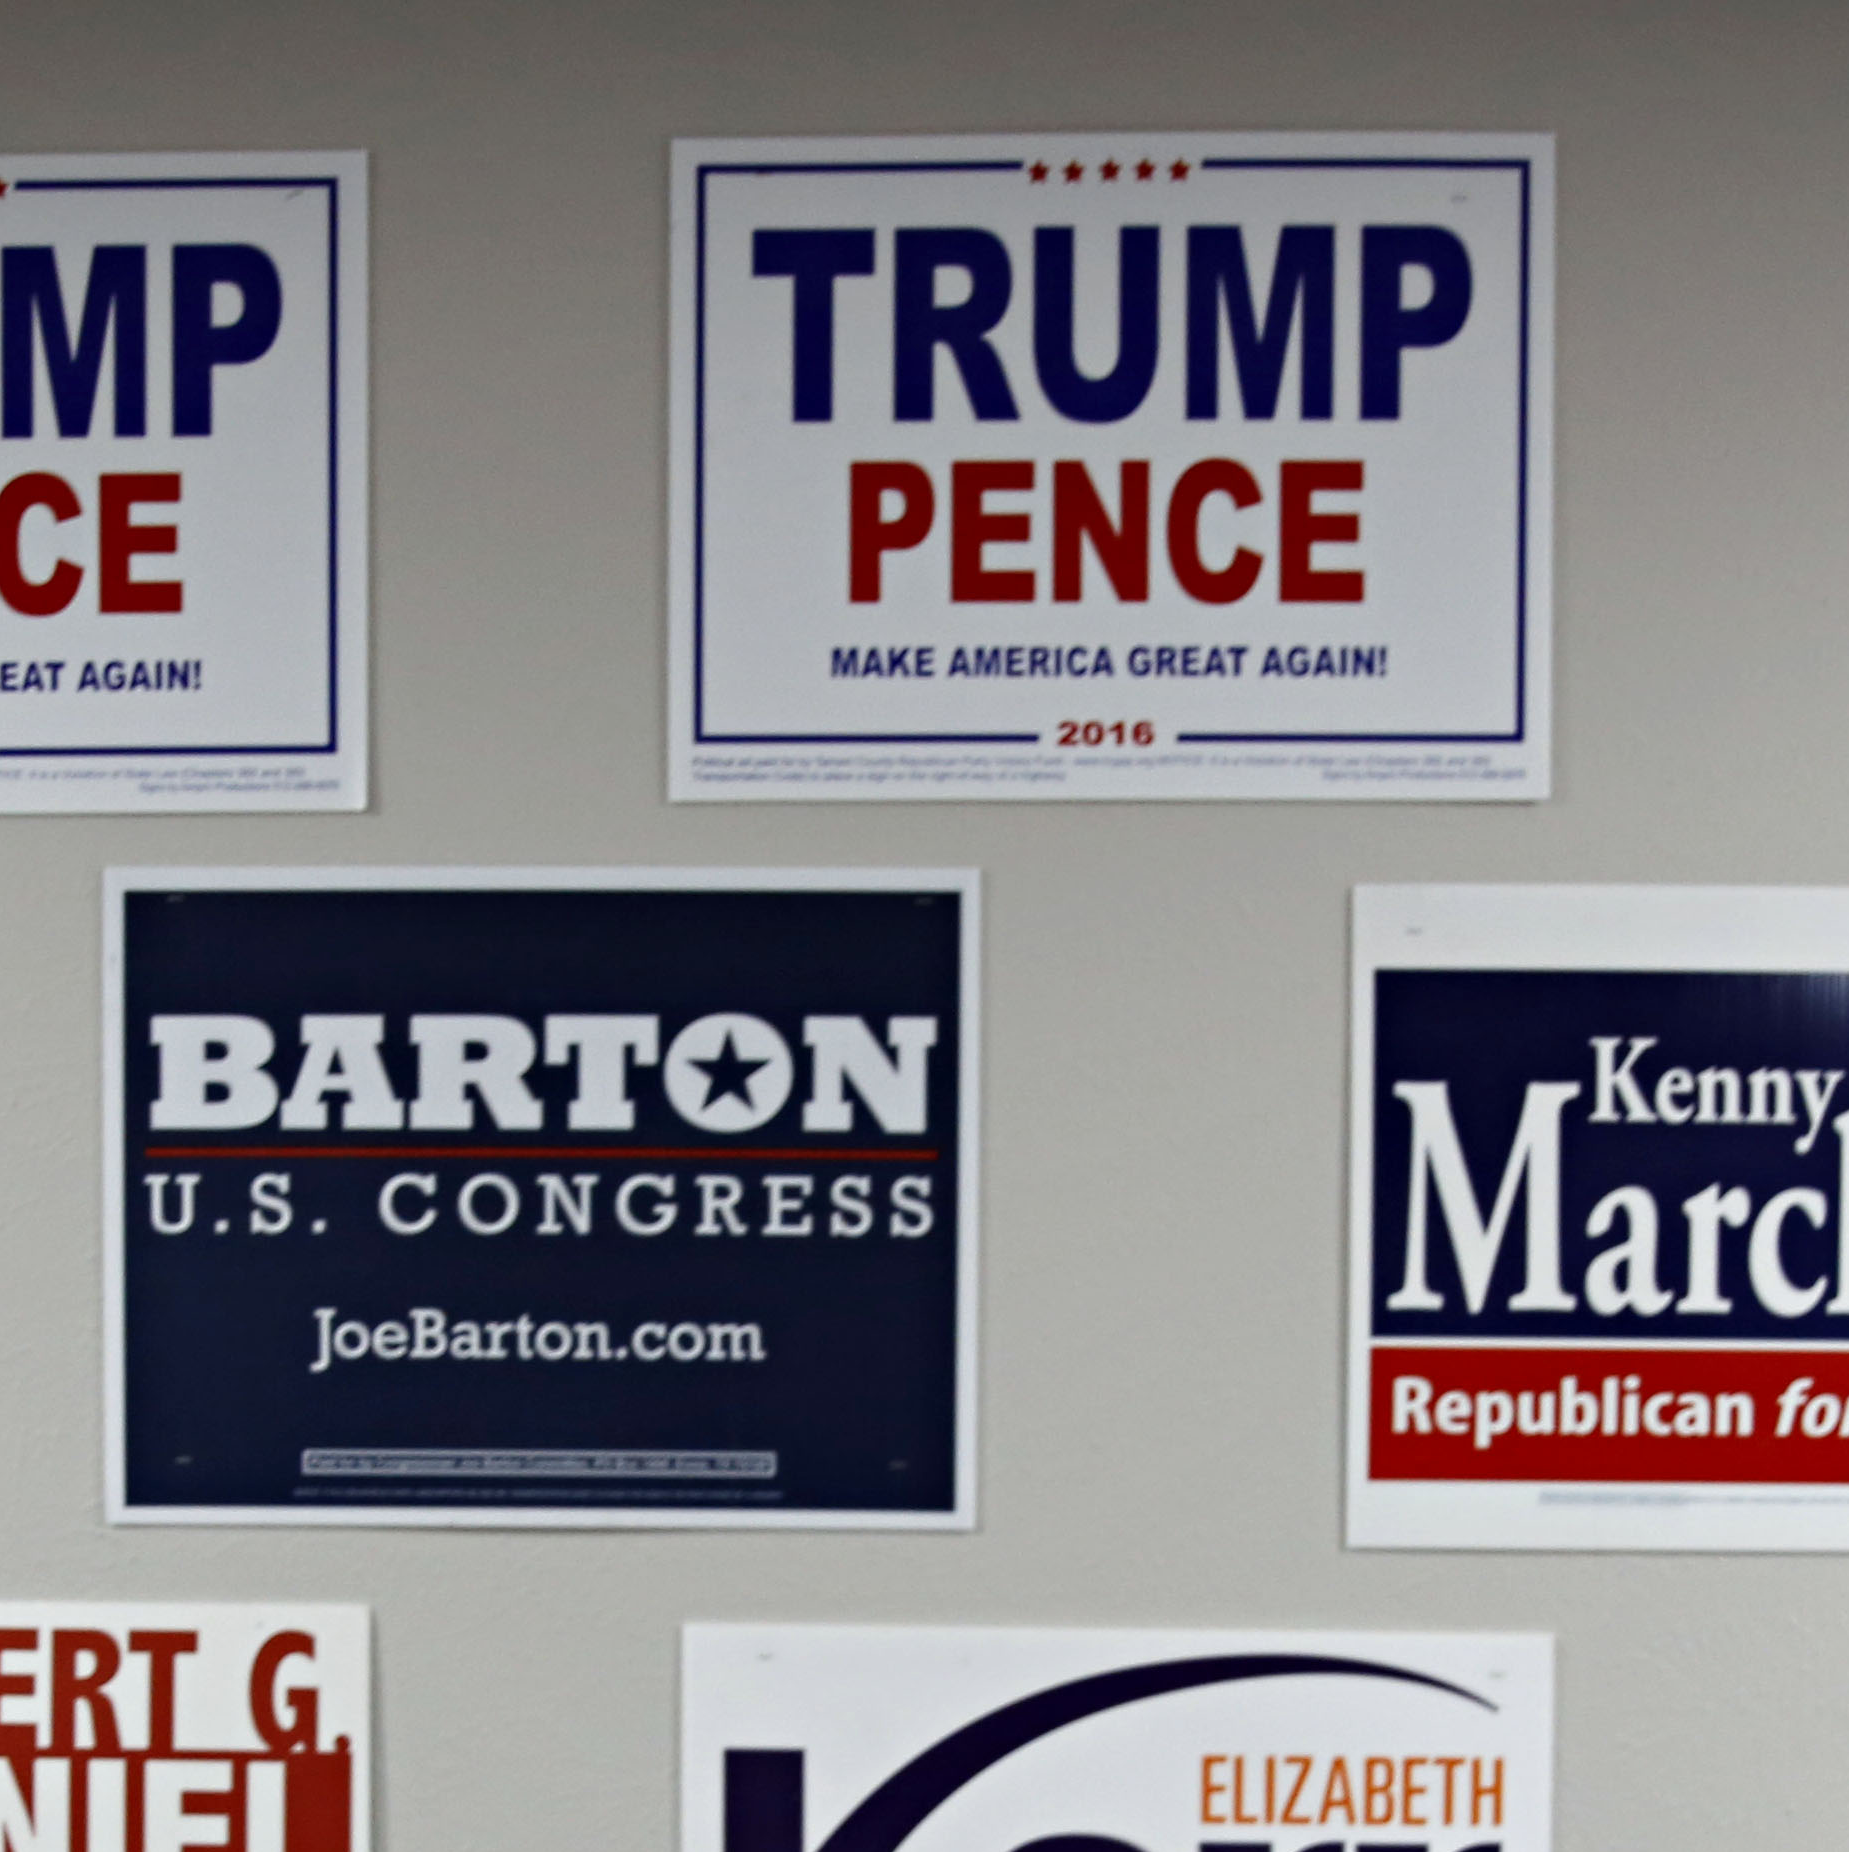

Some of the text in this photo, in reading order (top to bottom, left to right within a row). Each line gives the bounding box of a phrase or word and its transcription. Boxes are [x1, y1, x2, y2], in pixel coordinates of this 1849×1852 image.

[753, 225, 1472, 423] TRUMP
[850, 458, 1365, 603] PENCE
[79, 661, 201, 692] AGAIN!
[832, 646, 1386, 678] MAKE AMERICA GREAT AGAIN!
[1057, 721, 1153, 745] 2016
[150, 1013, 938, 1135] BARTON
[1588, 1036, 1844, 1153] Kenny
[145, 1174, 934, 1238] U.S. CONGRESS
[311, 1307, 764, 1371] JoeBarton.com
[1391, 1375, 1753, 1450] Republican
[1200, 1755, 1503, 1825] ELIZABETH
